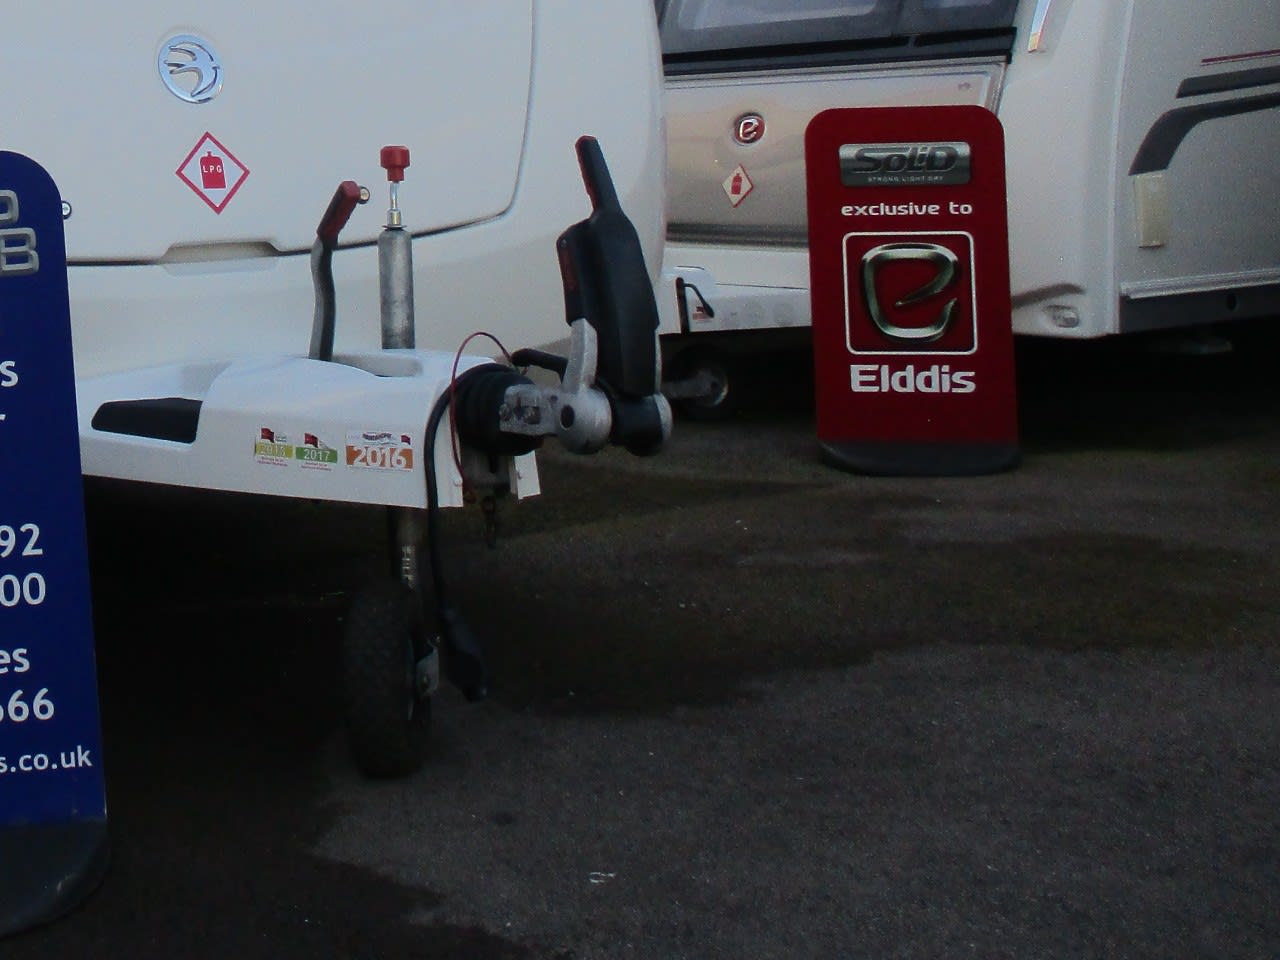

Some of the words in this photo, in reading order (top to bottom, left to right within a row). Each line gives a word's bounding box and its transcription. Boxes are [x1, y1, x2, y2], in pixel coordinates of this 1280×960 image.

[203, 165, 222, 173] LPG
[841, 202, 941, 216] exclusive
[949, 201, 973, 215] to
[850, 364, 976, 394] Elddis
[304, 449, 330, 462] 2017
[353, 445, 407, 468] 2016
